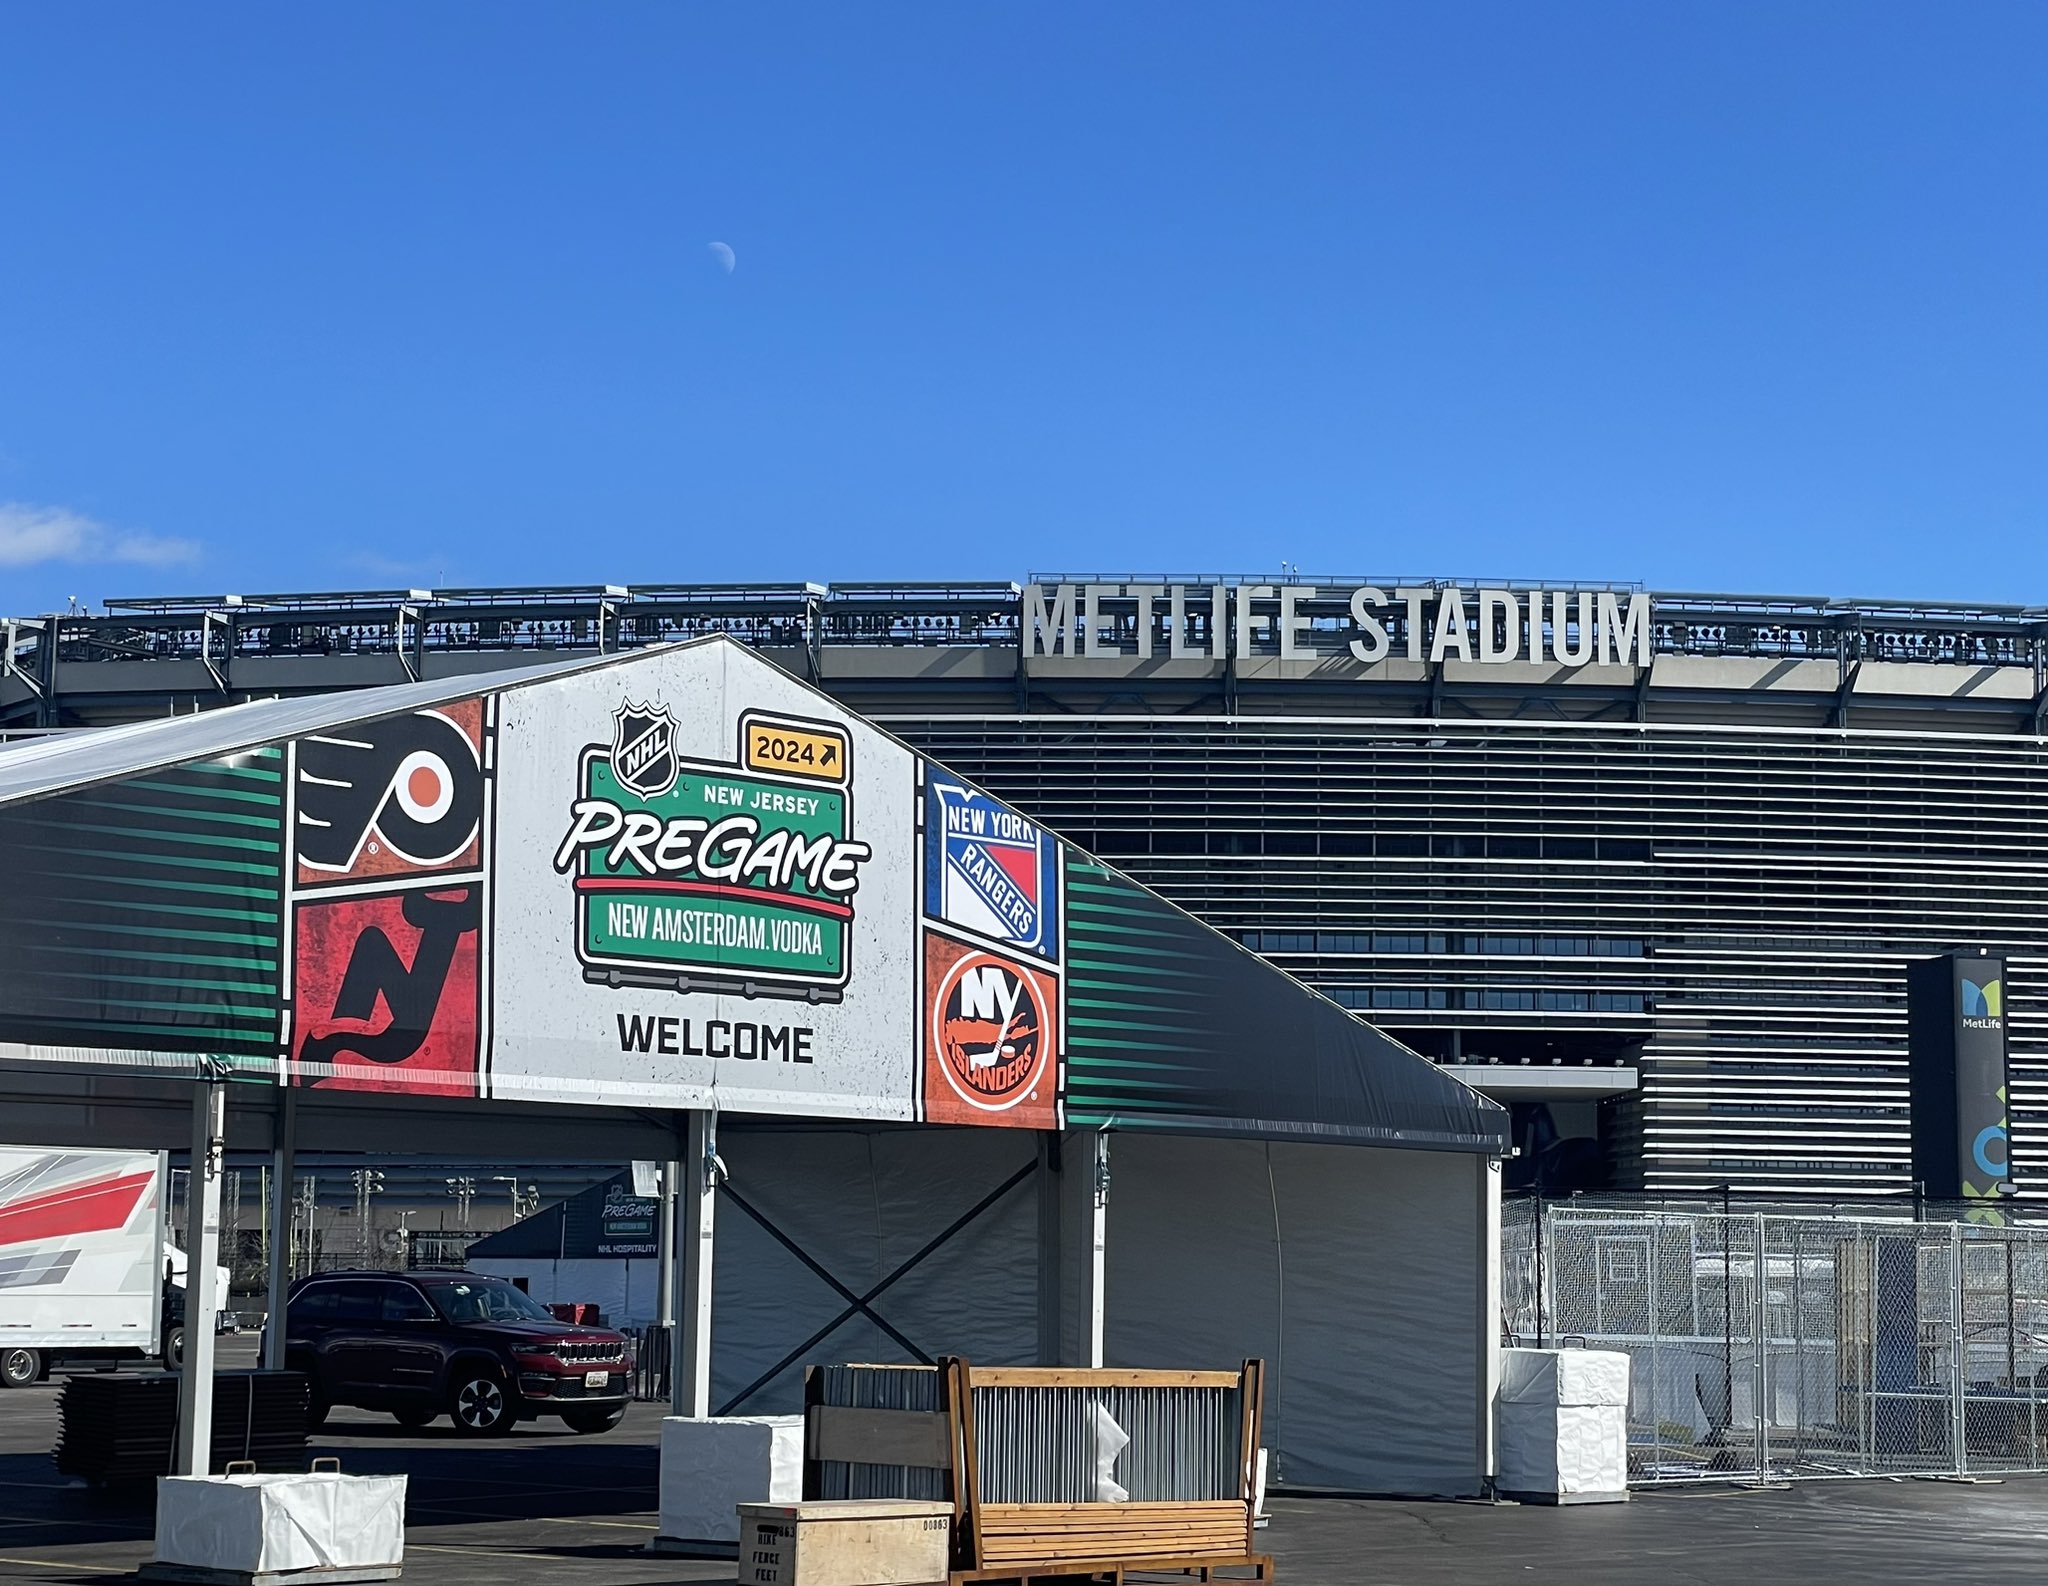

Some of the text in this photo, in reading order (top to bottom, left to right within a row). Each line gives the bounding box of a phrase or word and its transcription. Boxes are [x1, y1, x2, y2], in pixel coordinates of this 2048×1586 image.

[1022, 584, 1652, 669] METLIFE STADIUM
[626, 727, 668, 777] NHL
[757, 735, 815, 765] 2024
[704, 784, 819, 816] NEW JERSEY
[949, 805, 986, 835] NEW
[555, 799, 871, 893] PREGAME
[960, 842, 1034, 935] RANGERS
[608, 902, 649, 940] NEW
[770, 919, 823, 956] VODKA
[960, 966, 1024, 1030] NY
[616, 1013, 814, 1064] WELCOME
[1962, 1018, 2001, 1029] MetLife
[951, 1042, 1032, 1092] ISLANDERS
[601, 1203, 657, 1219] PREGAME
[598, 1244, 657, 1254] NHL HOSPITALITY
[755, 1568, 778, 1582] FEET
